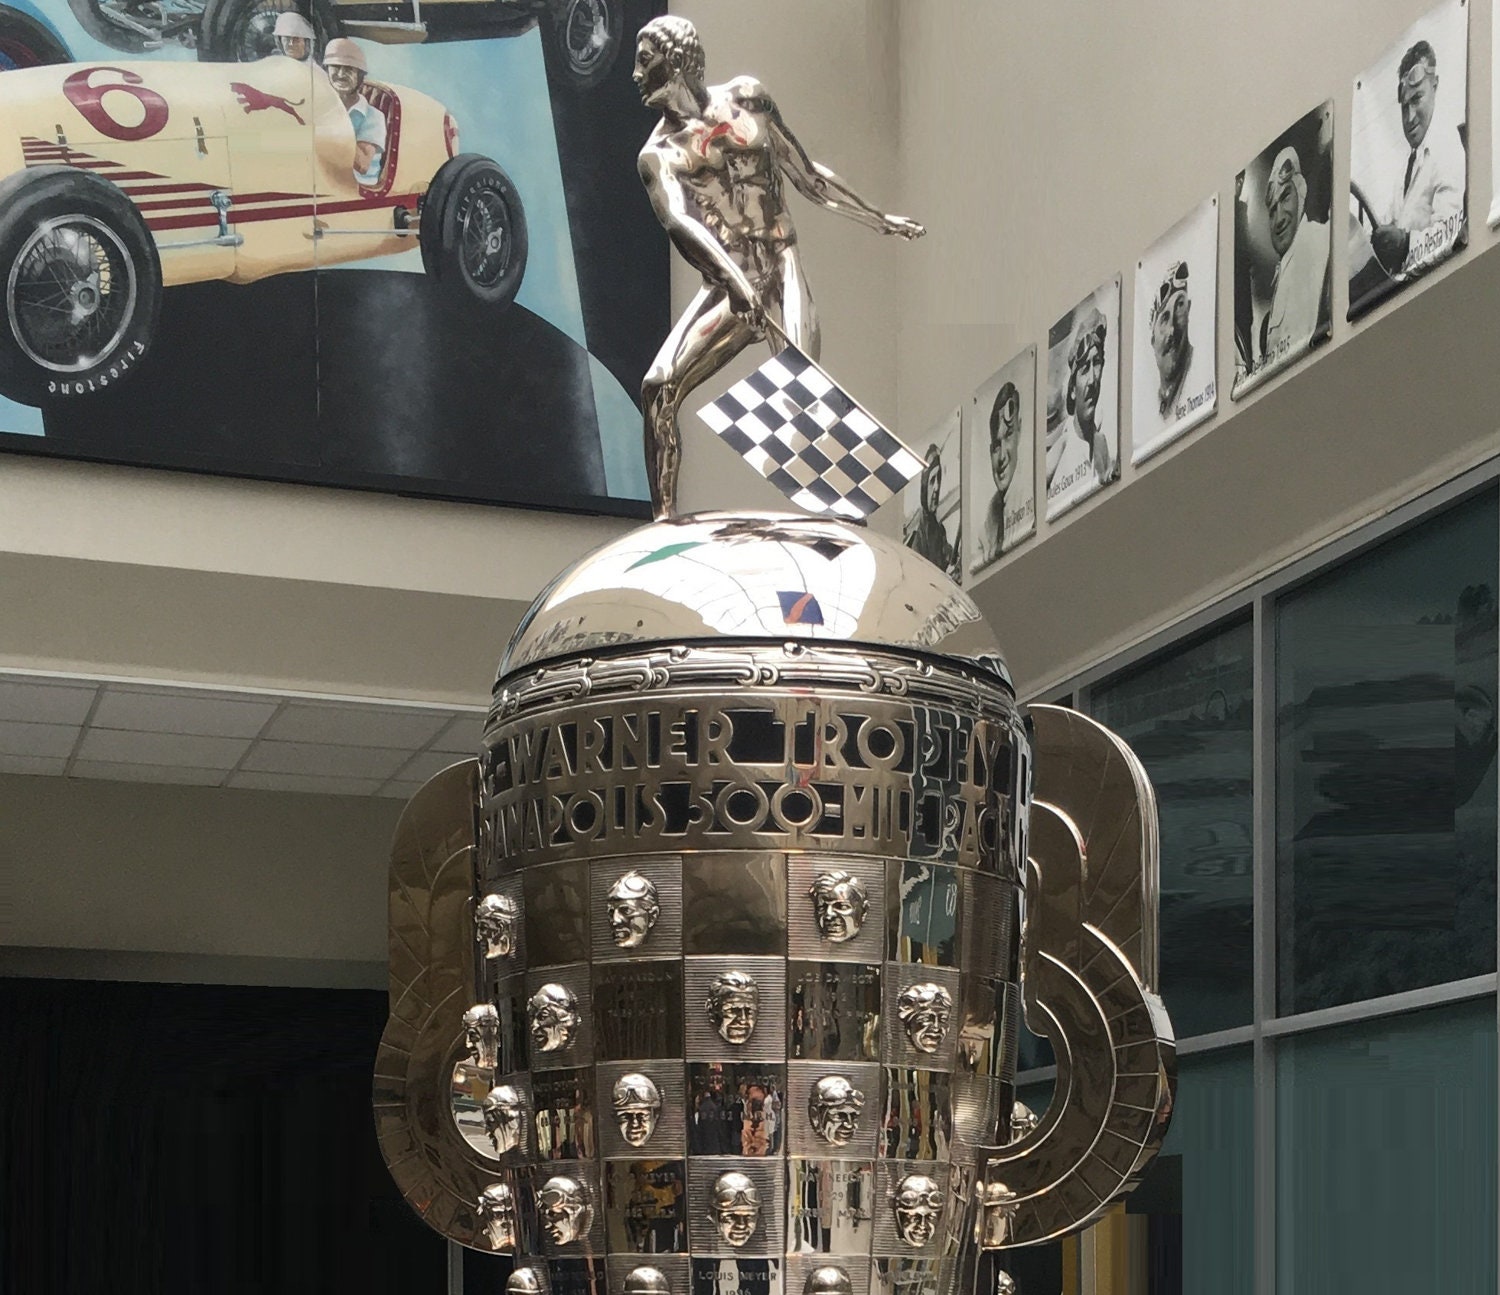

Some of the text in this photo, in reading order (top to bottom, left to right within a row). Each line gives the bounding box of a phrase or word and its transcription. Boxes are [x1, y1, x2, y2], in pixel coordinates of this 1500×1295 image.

[63, 67, 169, 140] 6
[48, 340, 145, 394] Firestone
[698, 1270, 777, 1281] LOUIS MEYER
